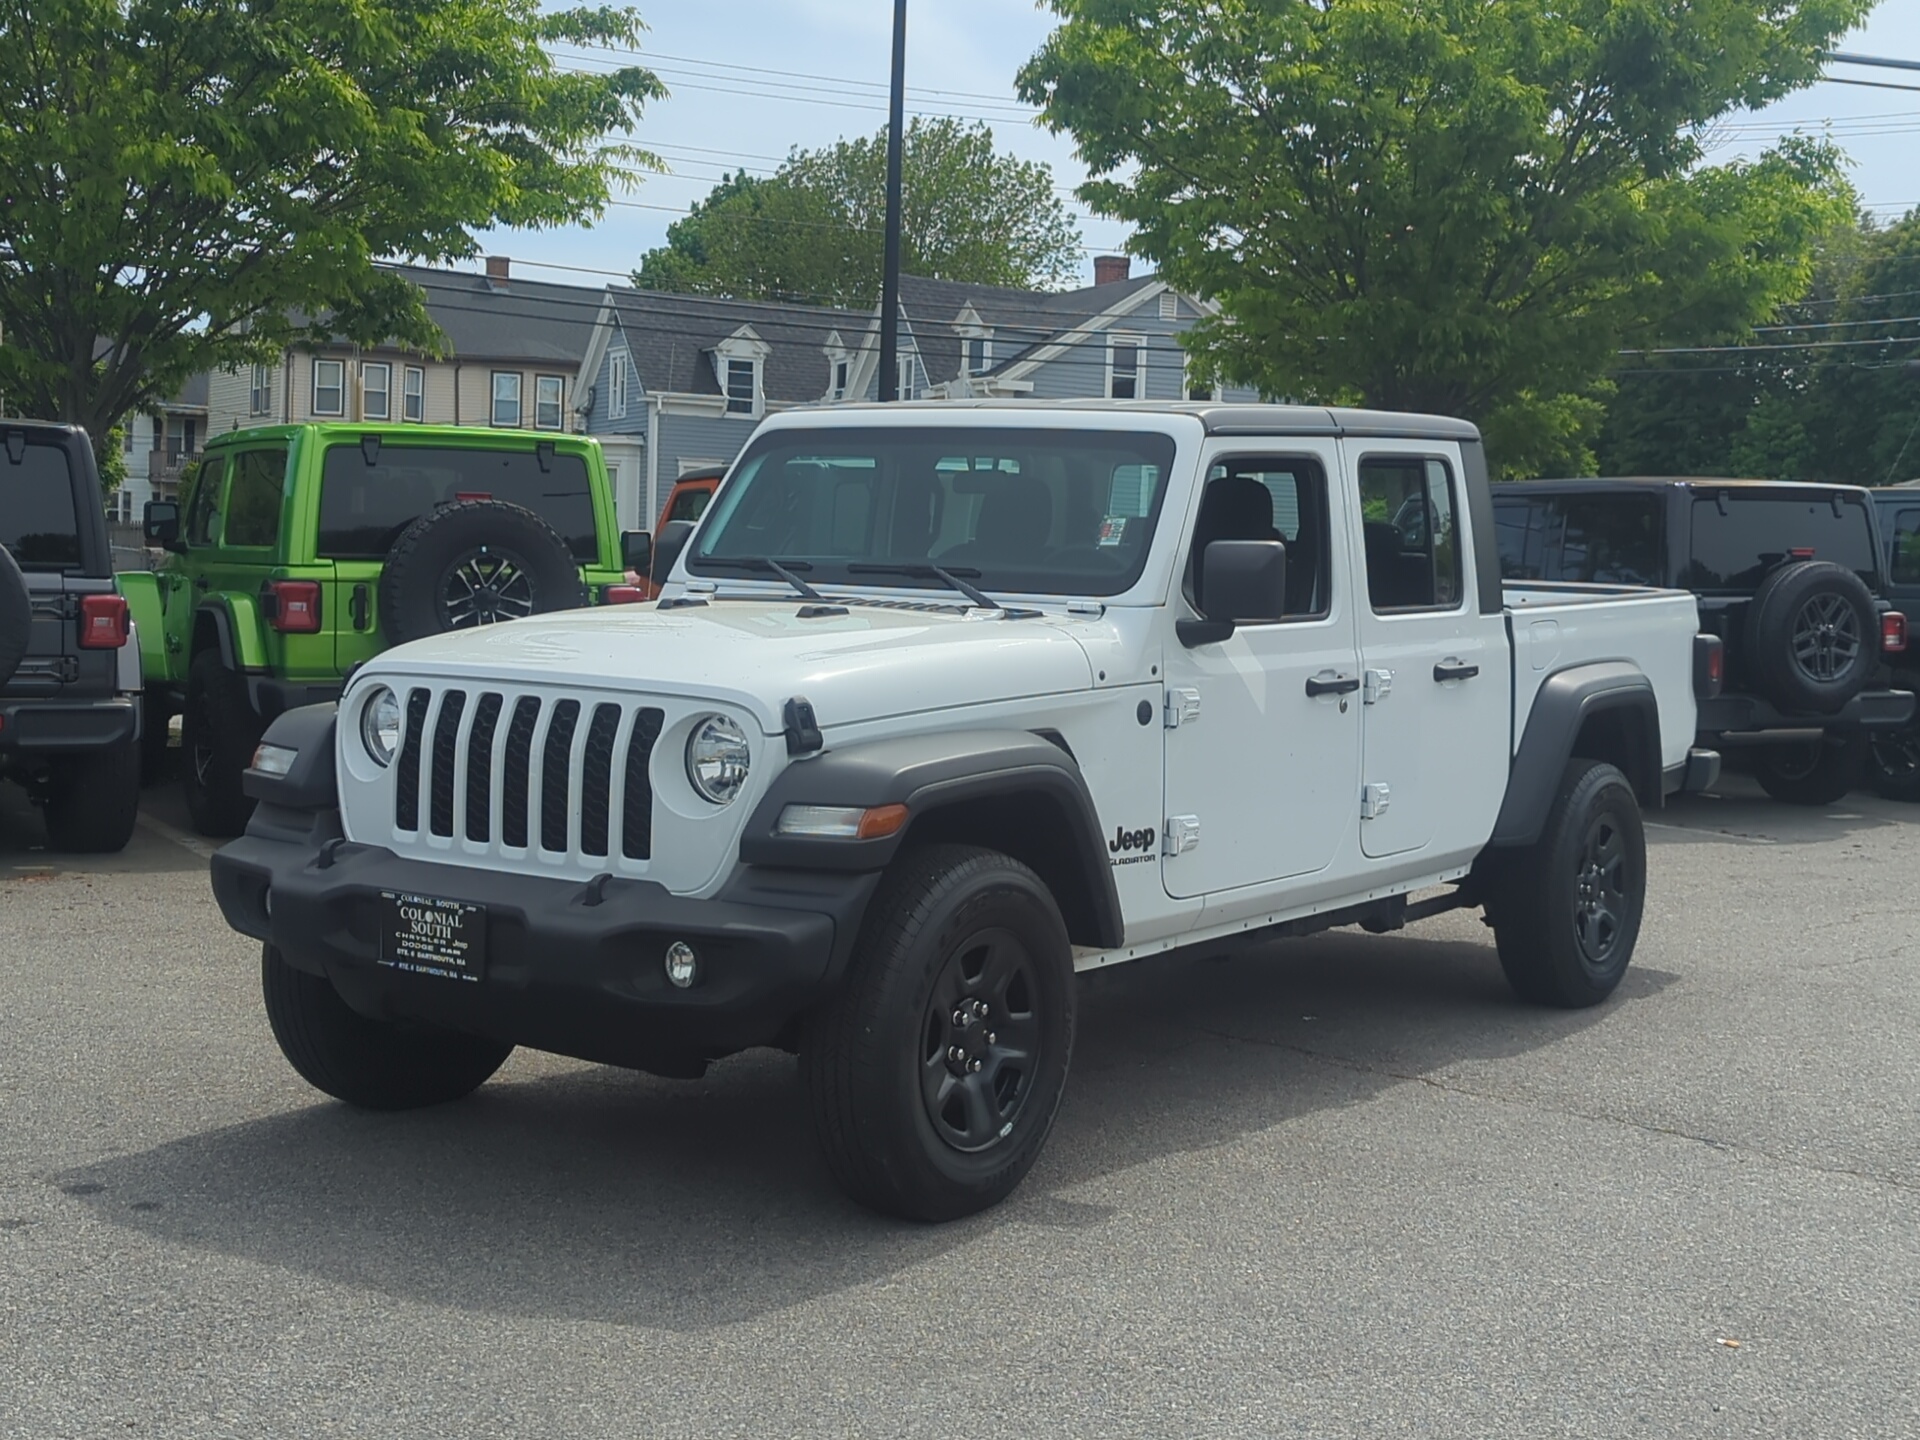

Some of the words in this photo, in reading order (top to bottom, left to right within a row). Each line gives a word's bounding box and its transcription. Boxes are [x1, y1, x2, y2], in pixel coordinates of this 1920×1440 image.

[1109, 826, 1155, 853] Jeep
[401, 894, 433, 906] COLONIAL
[436, 900, 459, 910] SOUTH
[400, 906, 463, 928] COLONIAL
[395, 931, 446, 946] CHRYSLER
[411, 921, 451, 939] SOUTH
[402, 940, 434, 951] DODGE
[440, 947, 461, 956] RAM
